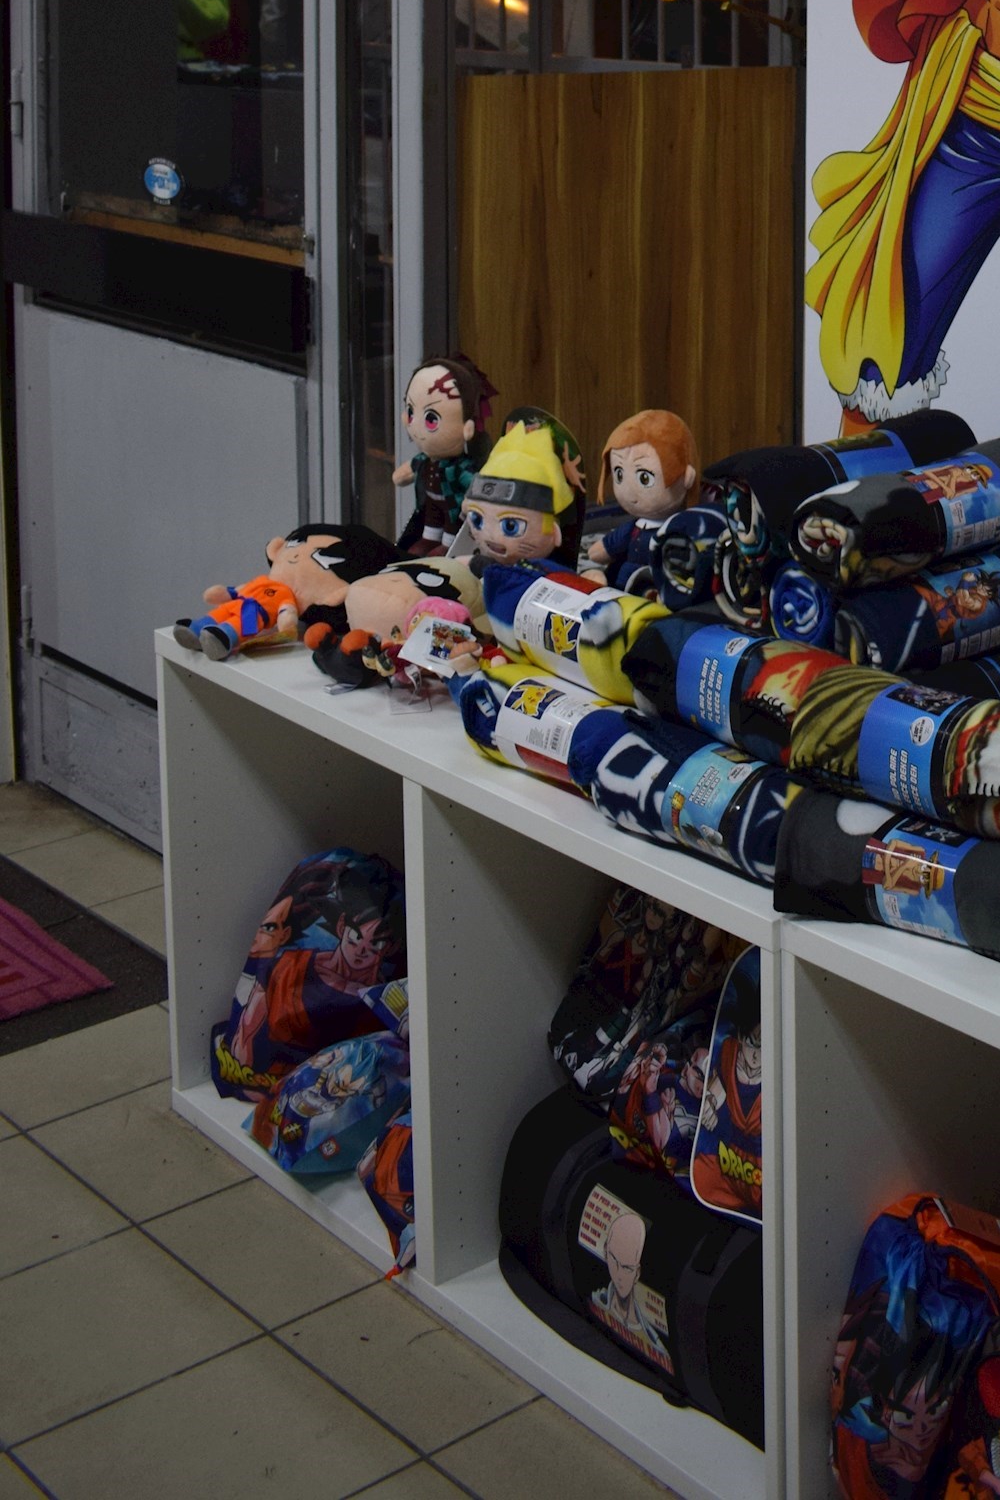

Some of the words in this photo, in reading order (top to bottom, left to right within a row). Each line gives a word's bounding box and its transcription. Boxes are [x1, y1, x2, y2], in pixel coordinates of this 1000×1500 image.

[698, 656, 711, 695] POLAIRE
[707, 657, 719, 688] DEKEN
[706, 687, 714, 723] FLEECE
[889, 747, 898, 788] POLAIRE
[899, 749, 909, 783] DEKEN
